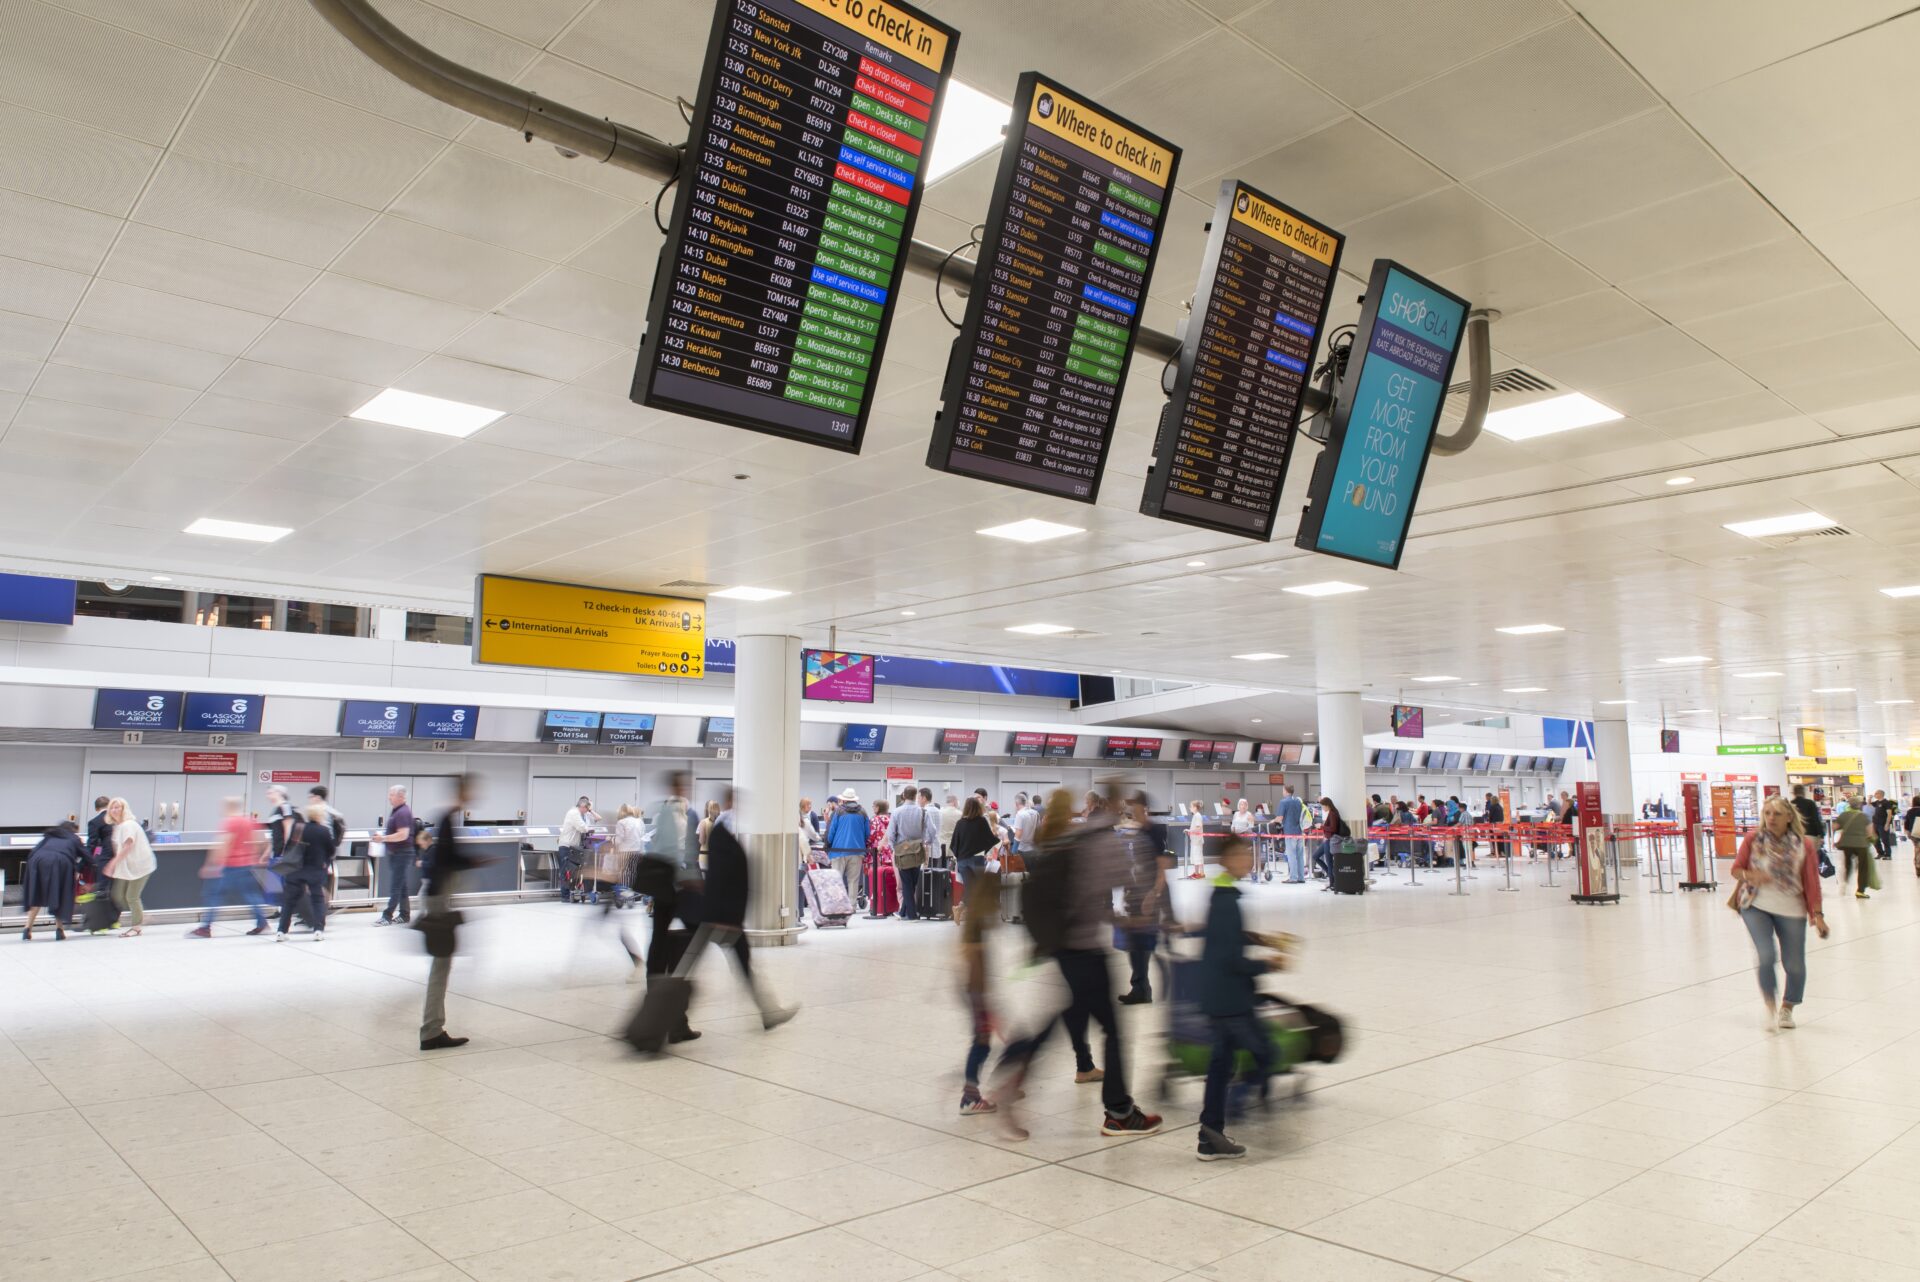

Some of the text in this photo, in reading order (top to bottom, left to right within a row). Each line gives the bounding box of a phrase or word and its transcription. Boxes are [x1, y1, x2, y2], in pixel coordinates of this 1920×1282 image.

[846, 0, 932, 55] to check in
[733, 19, 904, 107] 12:55 New York Jfk DL266 Check in closed
[737, 0, 910, 91] 12:50 Stansted EZY208 Bag drop closed
[865, 41, 892, 62] Remarks
[725, 57, 896, 141] 13:00 City Of Derry FR7722 Check in closed
[712, 114, 884, 192] 13:25 Amsterdam KL1476 Check in closed
[717, 96, 906, 182] 13:20 Birmingham BE787 Use self service kiosks
[1056, 104, 1161, 174] Where to check in
[1113, 167, 1131, 183] Remarks
[1251, 201, 1328, 254] Where to check in
[688, 227, 878, 297] 14:10 Birmingham BE789 Use self service kiosks
[680, 263, 700, 277] 14:15
[702, 270, 726, 285] Naples
[767, 290, 799, 307] TOM1544
[804, 303, 828, 317] Aperto
[857, 319, 874, 330] 15-17
[1080, 301, 1090, 312] Bag
[1090, 305, 1101, 315] drop
[1389, 292, 1447, 340] SHOPGLA
[1376, 338, 1440, 374] RATE ABROAD? SHOP HERE.
[1381, 328, 1443, 363] WHY RISK THE EXCHANGE
[661, 353, 680, 366] 14:30
[682, 359, 719, 376] Benbecula
[747, 376, 772, 389] BE6809
[785, 386, 803, 397] Open
[809, 392, 826, 404] Desks
[827, 397, 845, 407] 01-04
[1388, 373, 1417, 401] GET
[832, 420, 849, 432] 13:01
[1370, 399, 1415, 433] MORE
[1364, 425, 1406, 459] FROM
[1360, 455, 1398, 487] YOUR
[584, 601, 680, 619] T2 check-in desks 40-64
[636, 616, 680, 628] UK Arrivals
[512, 621, 608, 638] International Arrivals
[641, 650, 660, 658] Prayer
[126, 733, 139, 741] 11
